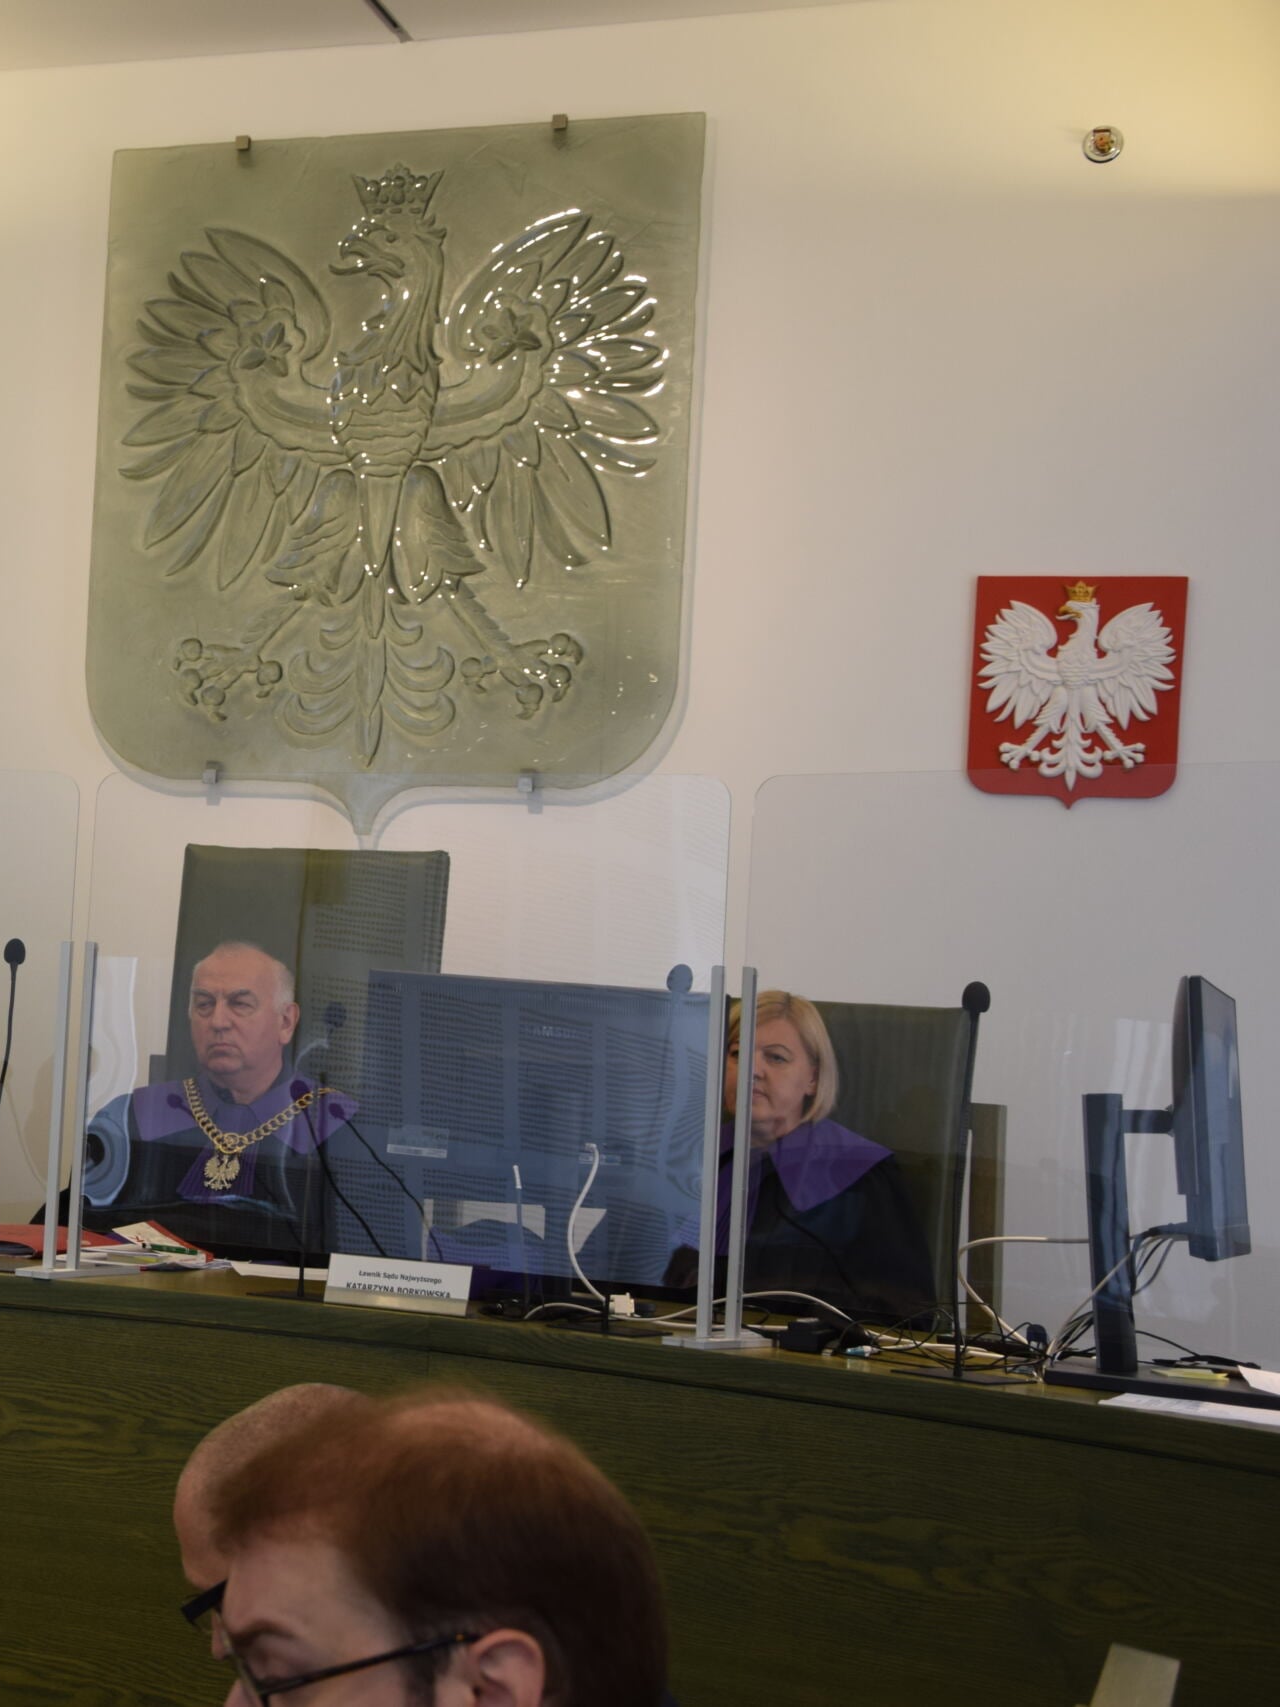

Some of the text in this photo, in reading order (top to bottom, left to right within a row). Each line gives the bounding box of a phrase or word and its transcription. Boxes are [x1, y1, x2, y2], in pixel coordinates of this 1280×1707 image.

[358, 1269, 444, 1286] Ławnik Sądu Najwyższego
[346, 1281, 451, 1299] KATARZYNA BORKOWSKA
